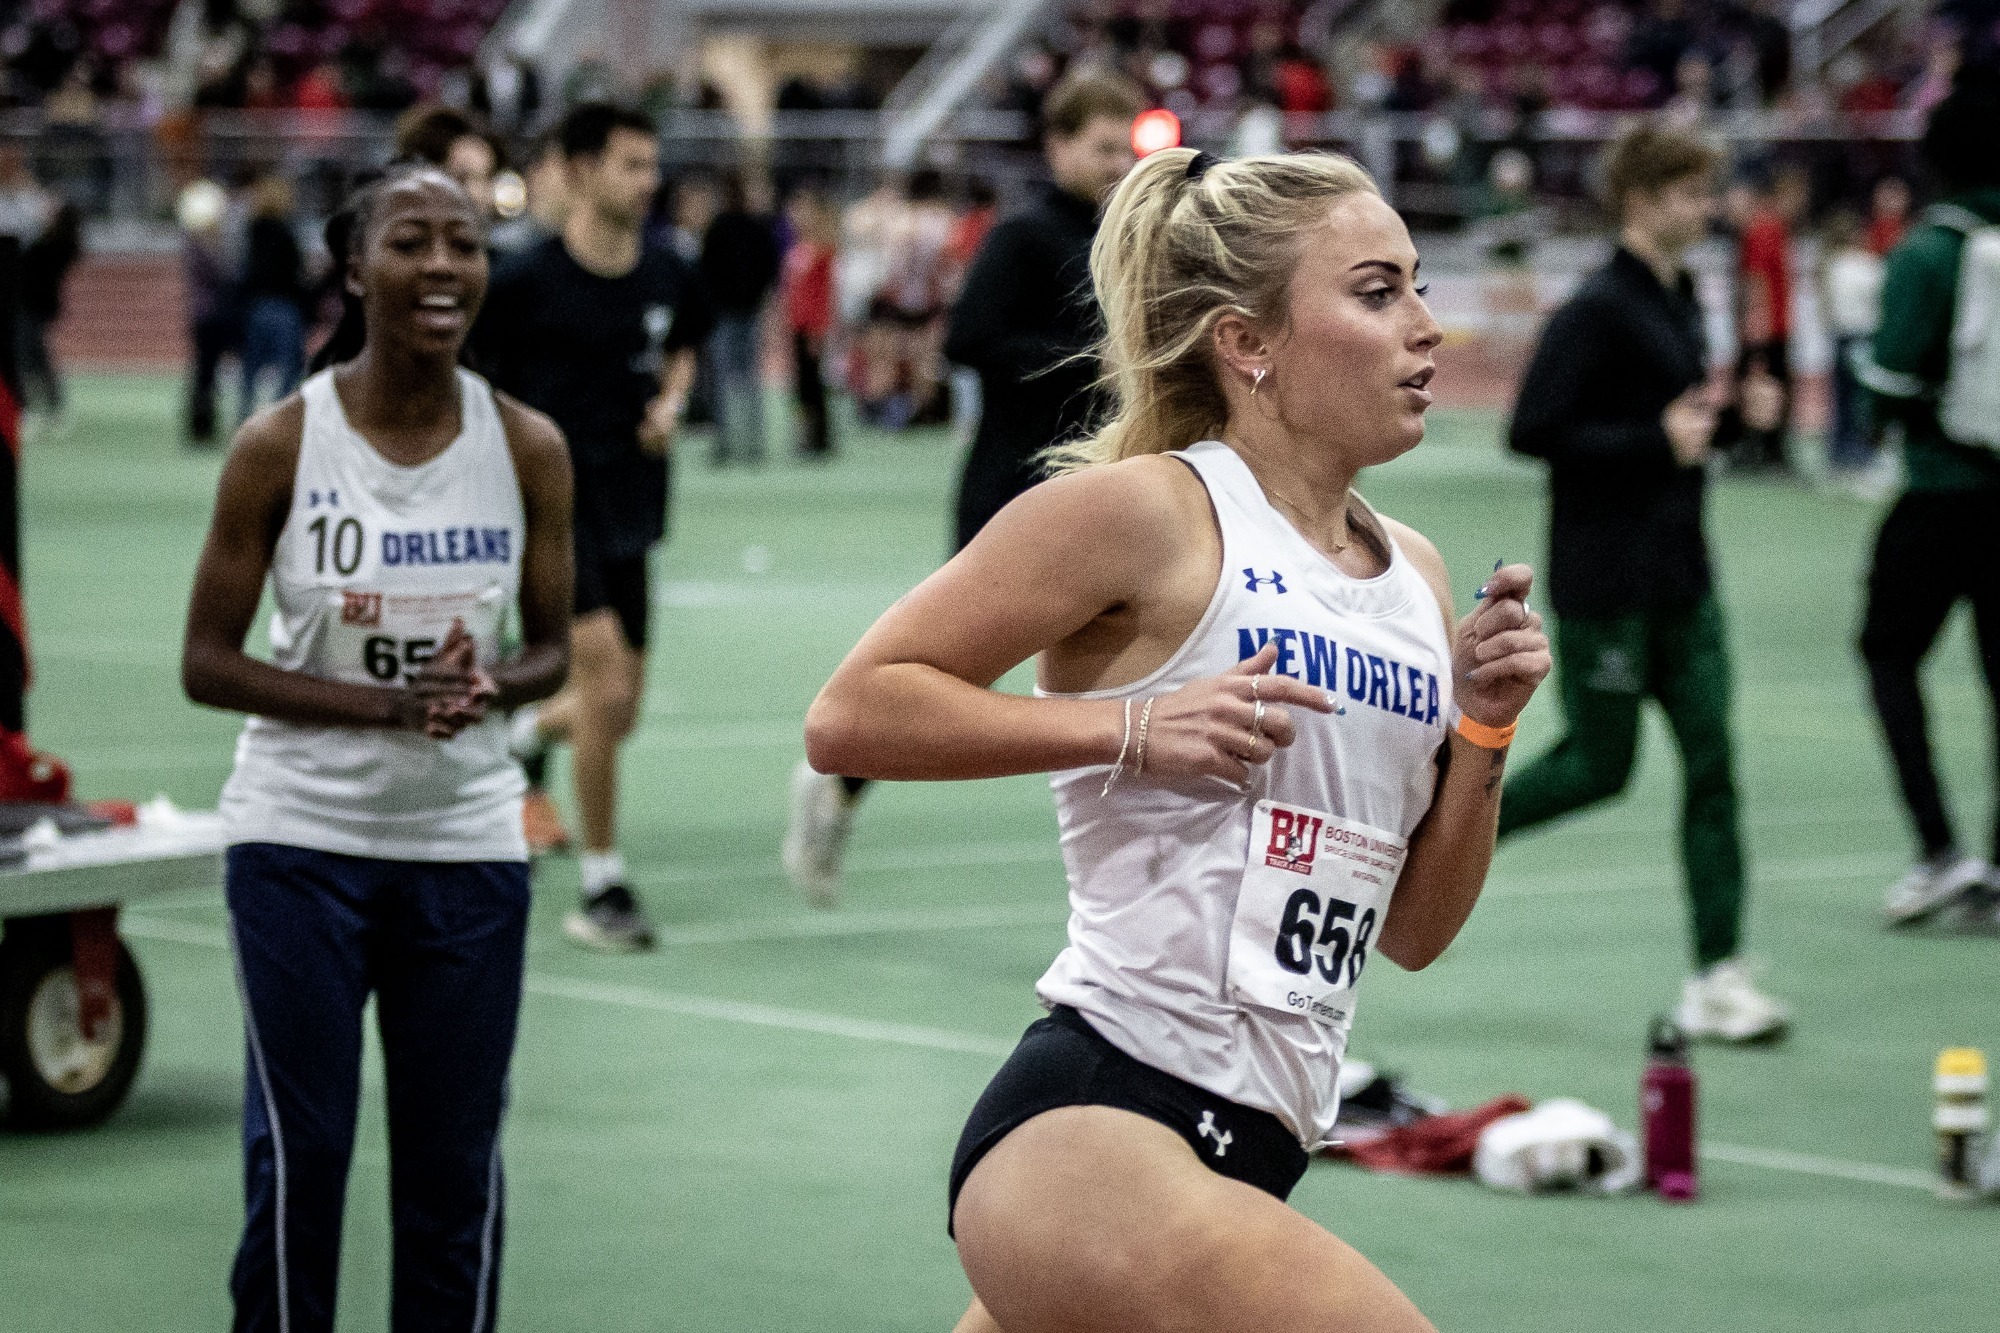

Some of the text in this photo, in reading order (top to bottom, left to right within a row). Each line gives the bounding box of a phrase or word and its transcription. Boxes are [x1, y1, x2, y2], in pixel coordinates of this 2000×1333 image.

[307, 515, 511, 577] 10 ORLEANS
[363, 636, 436, 682] 65
[1237, 628, 1440, 726] NEW ORLEA
[1266, 808, 1323, 864] BU
[1325, 826, 1368, 848] BOSTON
[1275, 888, 1376, 989] 658
